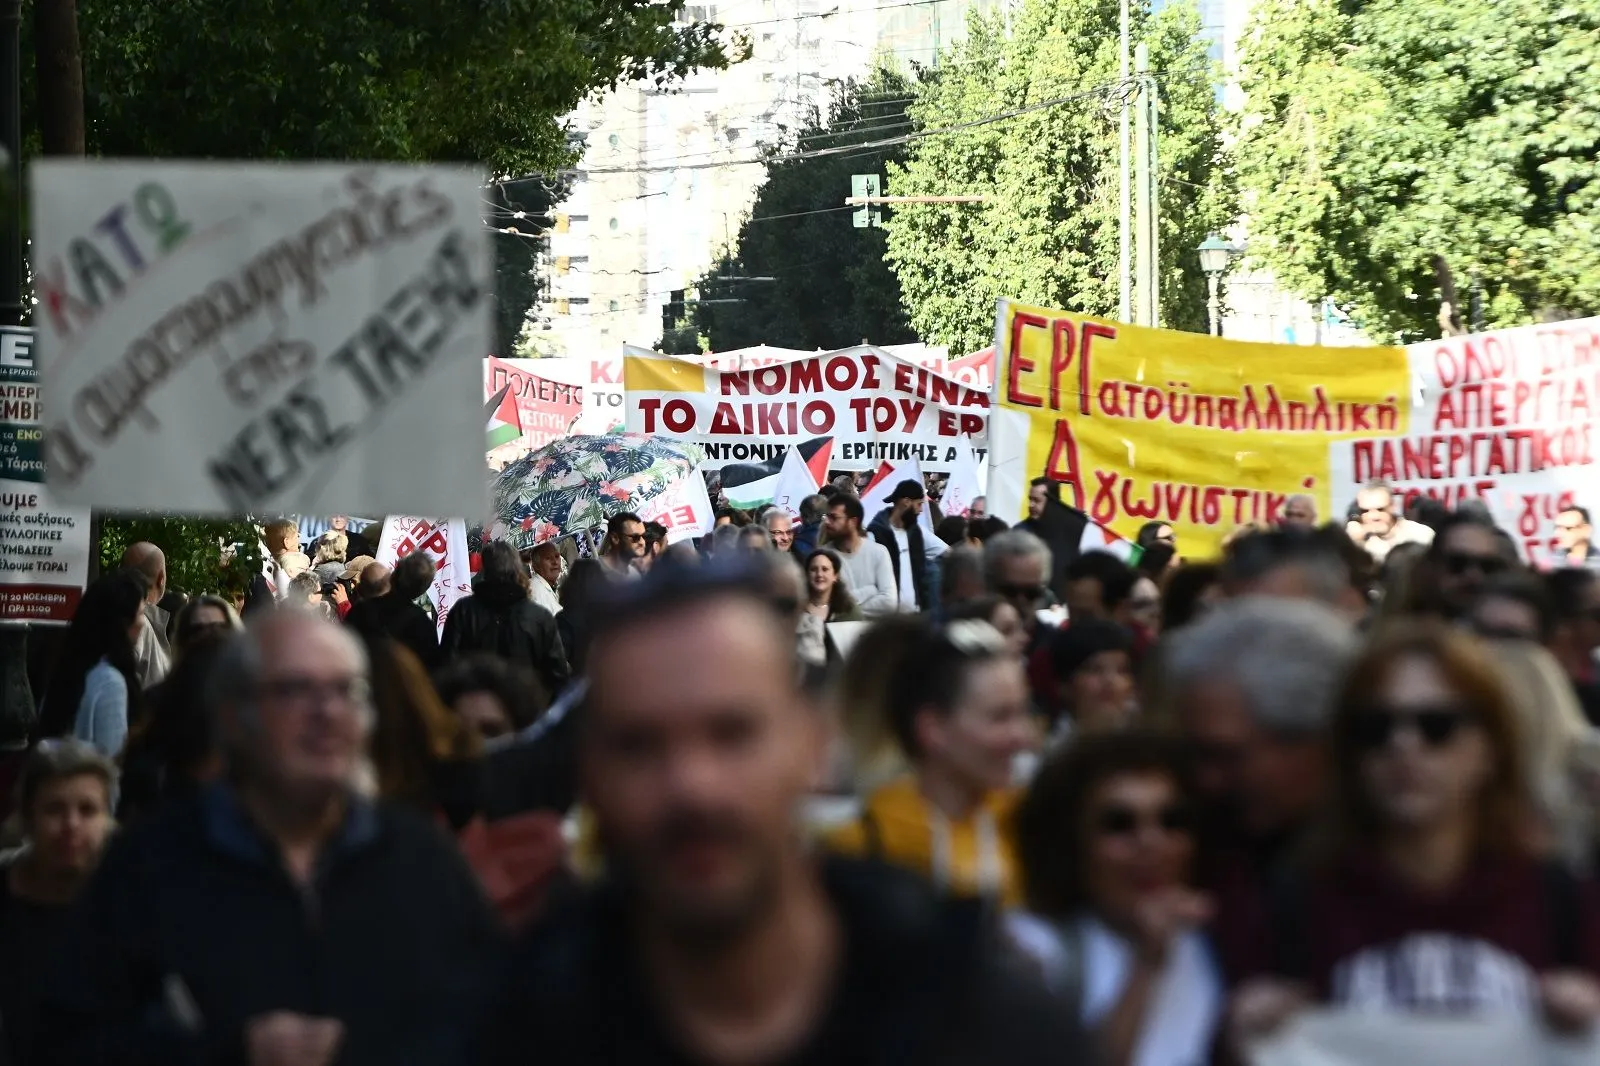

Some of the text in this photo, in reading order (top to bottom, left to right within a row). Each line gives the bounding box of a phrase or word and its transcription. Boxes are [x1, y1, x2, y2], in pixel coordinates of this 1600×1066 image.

[36, 180, 192, 337] ΚΑΤΩ
[720, 355, 880, 396] ΝΟΜΟΣ
[894, 363, 990, 408] ΕΙΝΑ
[1434, 371, 1600, 430] ΑΠΕΡΓΙΑ
[638, 397, 985, 437] ΤΟ ΔΙΚΙΟ ΤΟΥ ΕΡ
[1045, 419, 1315, 526] Αγωνιστικ
[0, 493, 37, 510] υμε
[24, 513, 75, 527] αυξήσεις,
[37, 561, 68, 572] ΤΩΡΑ!
[23, 592, 66, 603] ΝΟΕΜΒΡΗ
